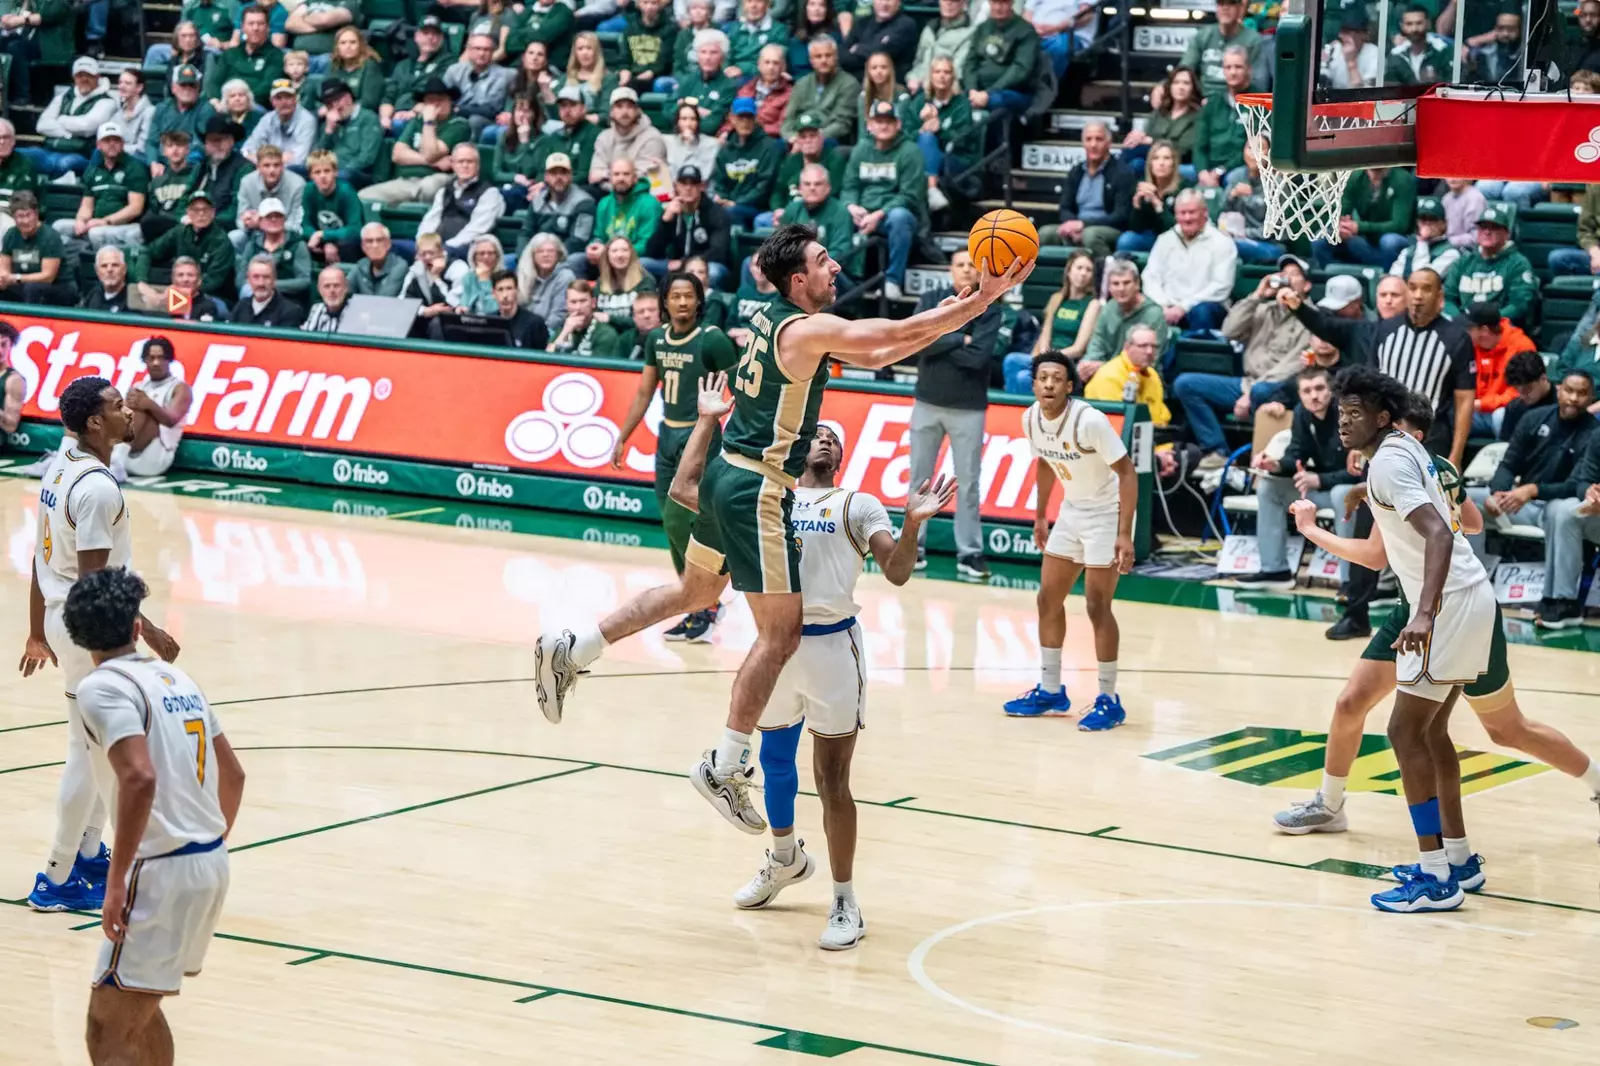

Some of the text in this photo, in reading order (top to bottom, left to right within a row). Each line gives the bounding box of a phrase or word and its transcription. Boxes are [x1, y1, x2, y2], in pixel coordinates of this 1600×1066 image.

[1154, 34, 1185, 46] RAM
[655, 351, 694, 363] COLORADO
[662, 359, 684, 369] STATE
[735, 329, 769, 398] 25
[10, 325, 185, 413] Stat
[664, 370, 680, 405] 11
[231, 449, 268, 471] fnbo
[352, 463, 389, 485] fnbo
[477, 477, 514, 498] fnbo
[604, 491, 643, 513] fnbo
[792, 520, 836, 534] RTANS
[43, 513, 53, 565] 9
[1013, 533, 1041, 555] fnb
[1502, 565, 1545, 585] Peder
[183, 718, 206, 789] 7
